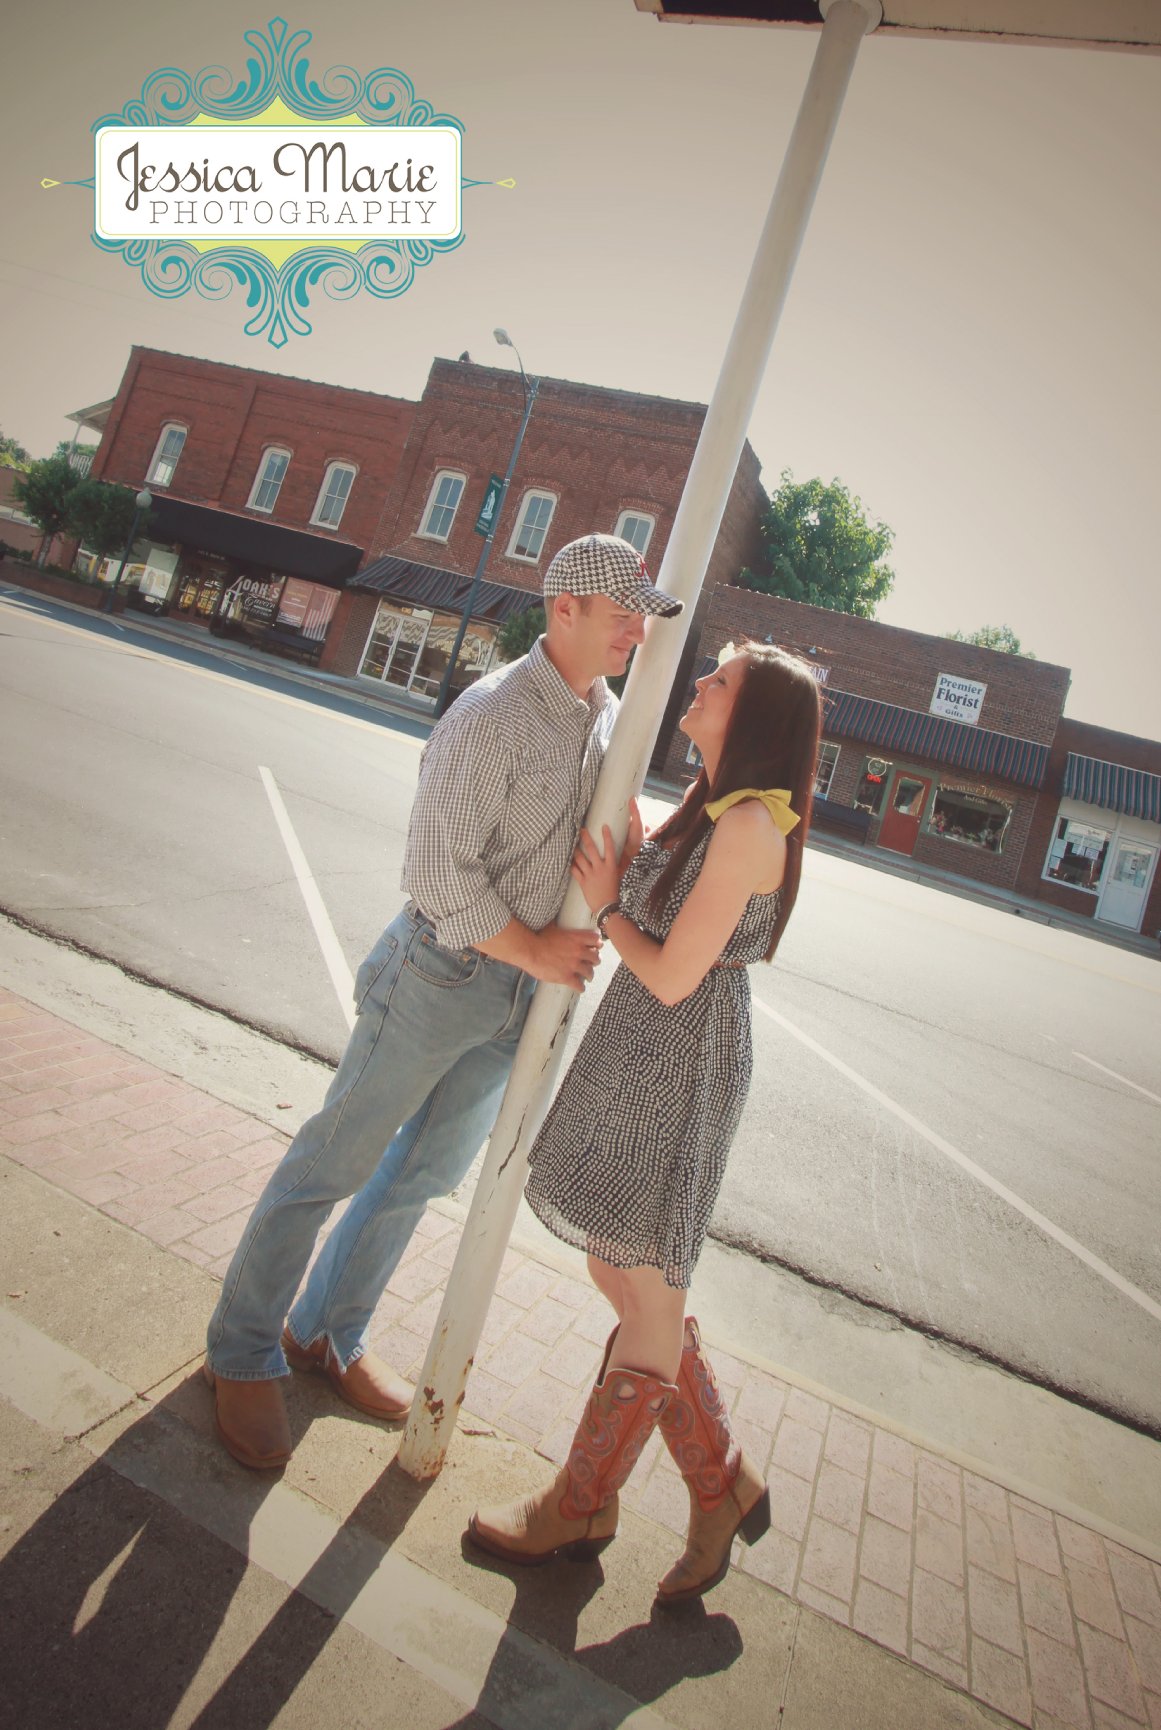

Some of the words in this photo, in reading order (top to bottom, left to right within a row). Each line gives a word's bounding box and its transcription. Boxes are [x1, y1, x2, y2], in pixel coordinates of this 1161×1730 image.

[940, 677, 983, 695] Premier
[936, 687, 979, 709] Florist
[945, 709, 963, 718] Gifts
